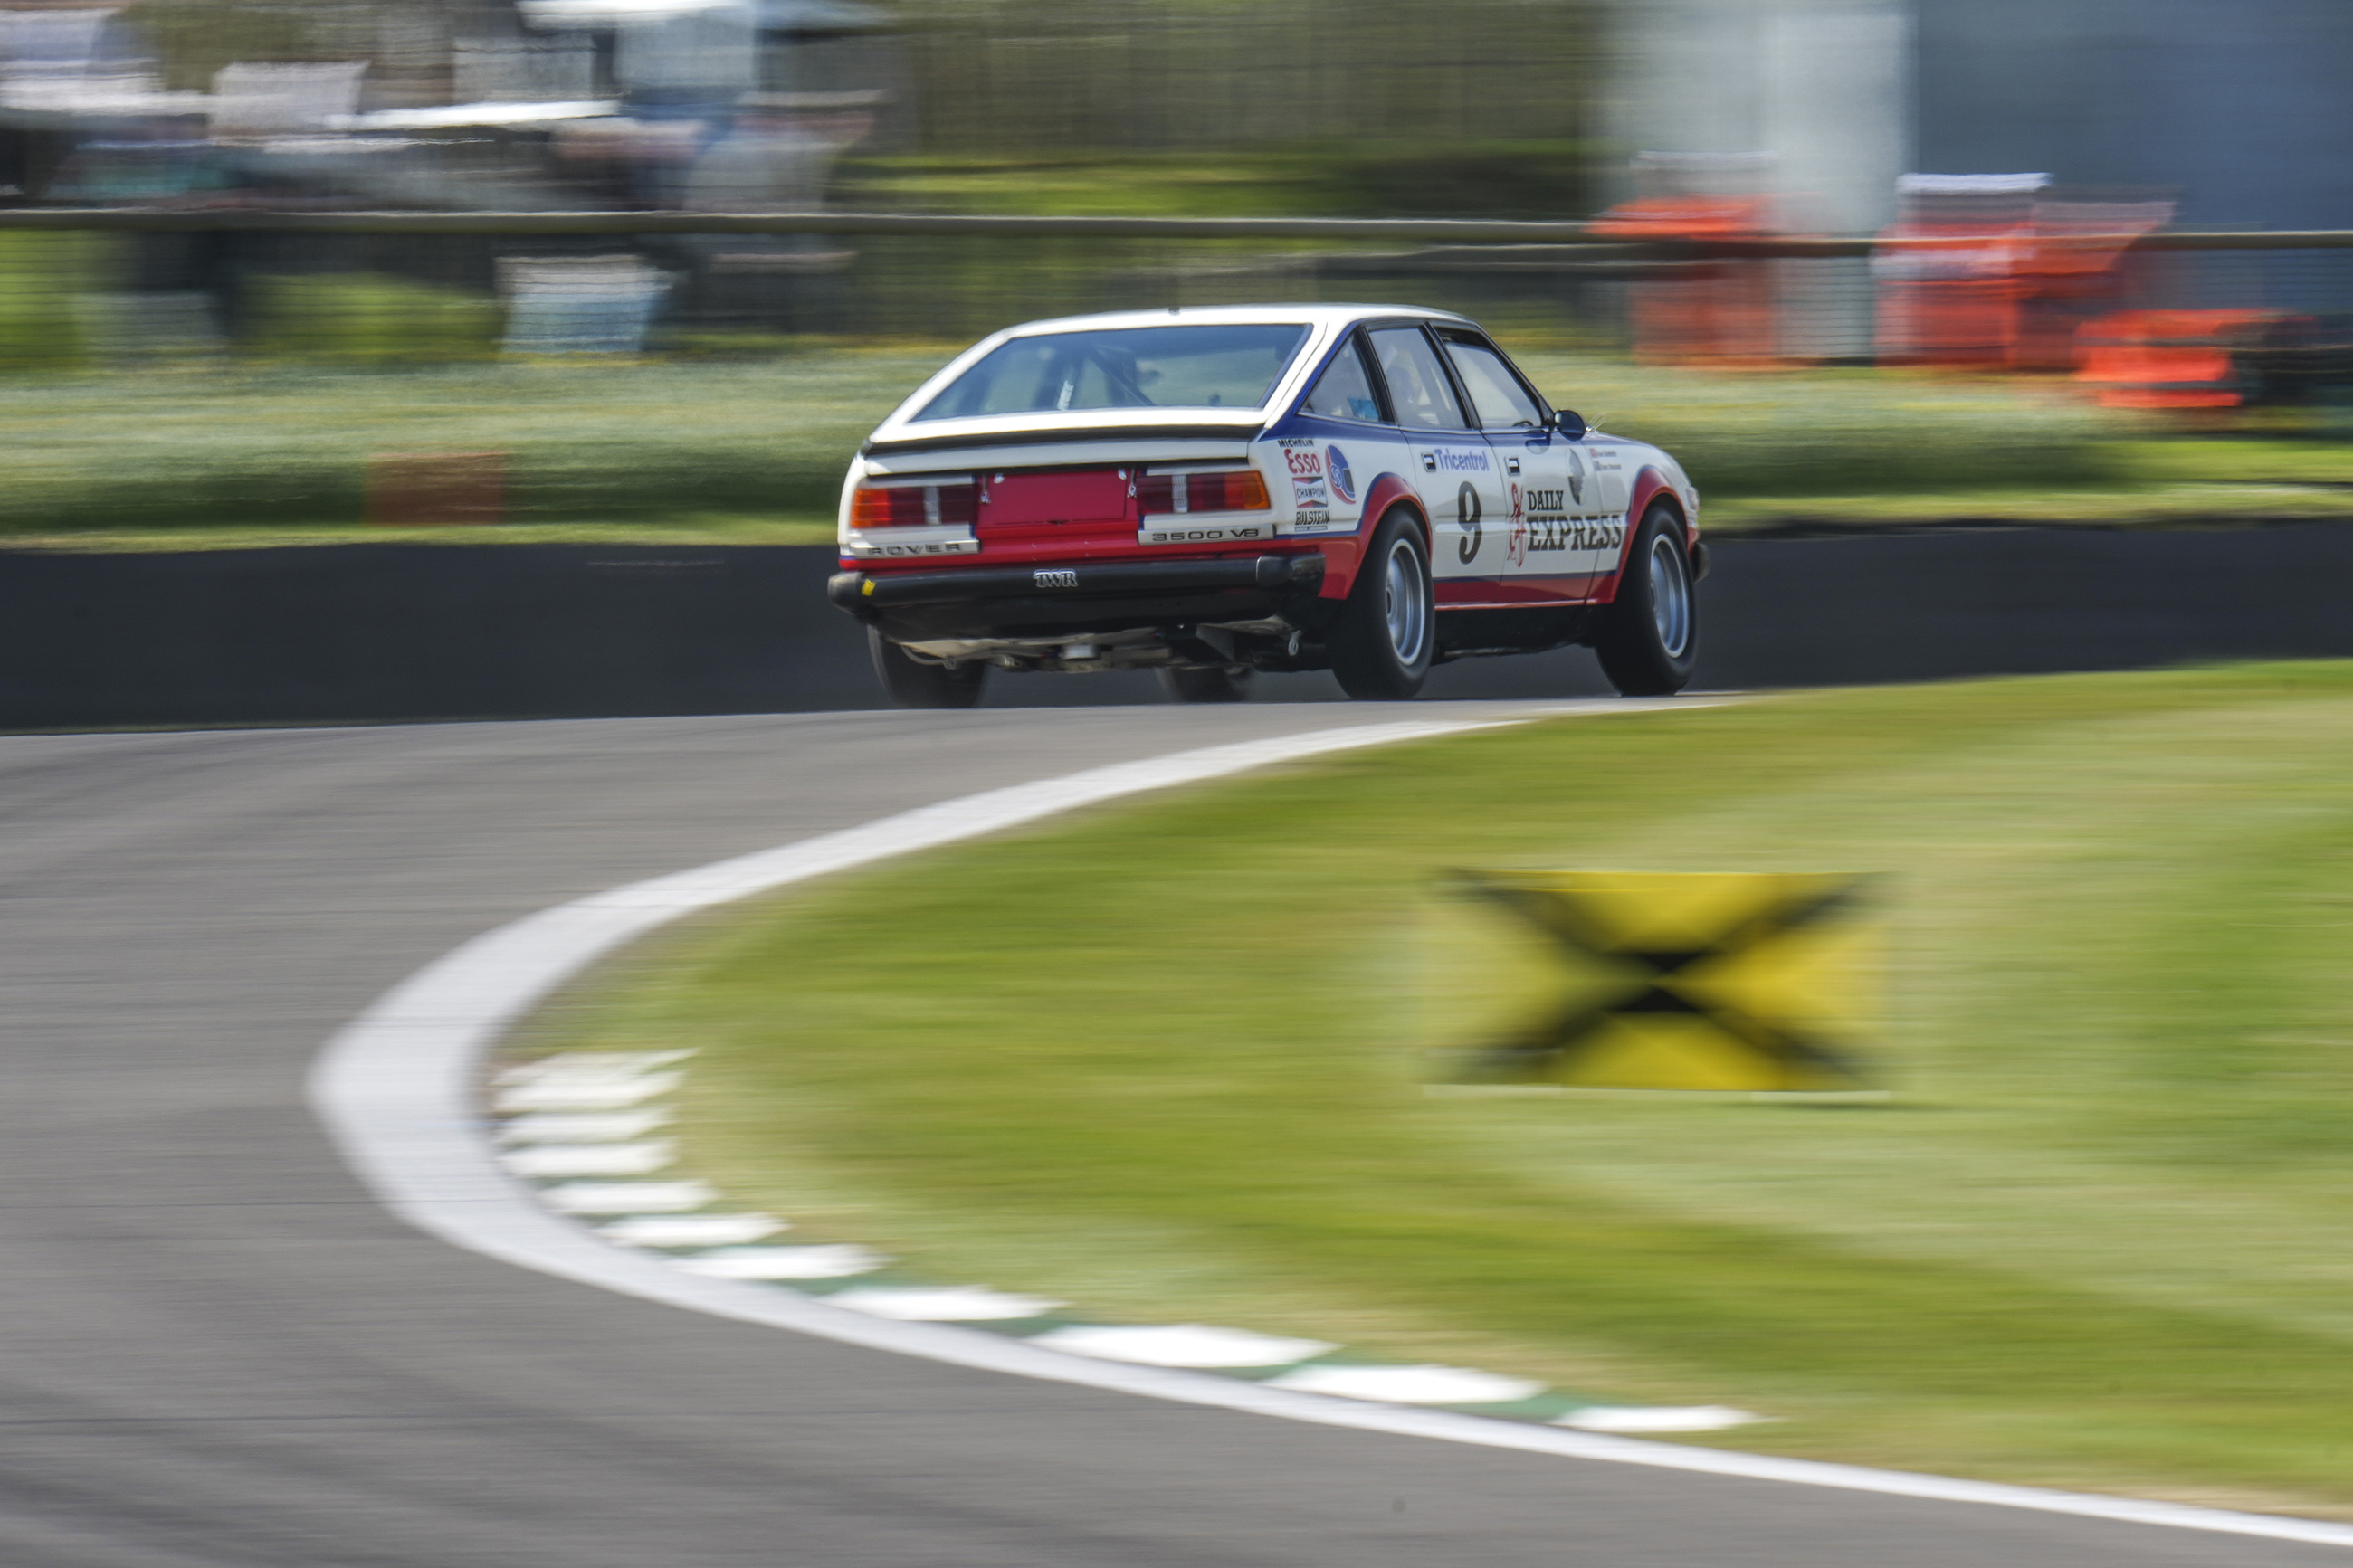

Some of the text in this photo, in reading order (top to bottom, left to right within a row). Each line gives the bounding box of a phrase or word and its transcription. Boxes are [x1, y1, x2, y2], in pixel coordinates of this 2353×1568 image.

[1278, 440, 1314, 448] MICHELIN
[1434, 448, 1490, 470] Tricentrol
[1296, 488, 1325, 499] CHAMPION
[1527, 490, 1564, 511] DAILY
[1295, 510, 1330, 526] BILSTEIN
[1458, 480, 1482, 565] 9
[1152, 528, 1260, 541] 3500 V8
[1526, 515, 1622, 551] EXPRESS
[869, 543, 962, 556] ROVER
[1034, 569, 1078, 588] TWR
